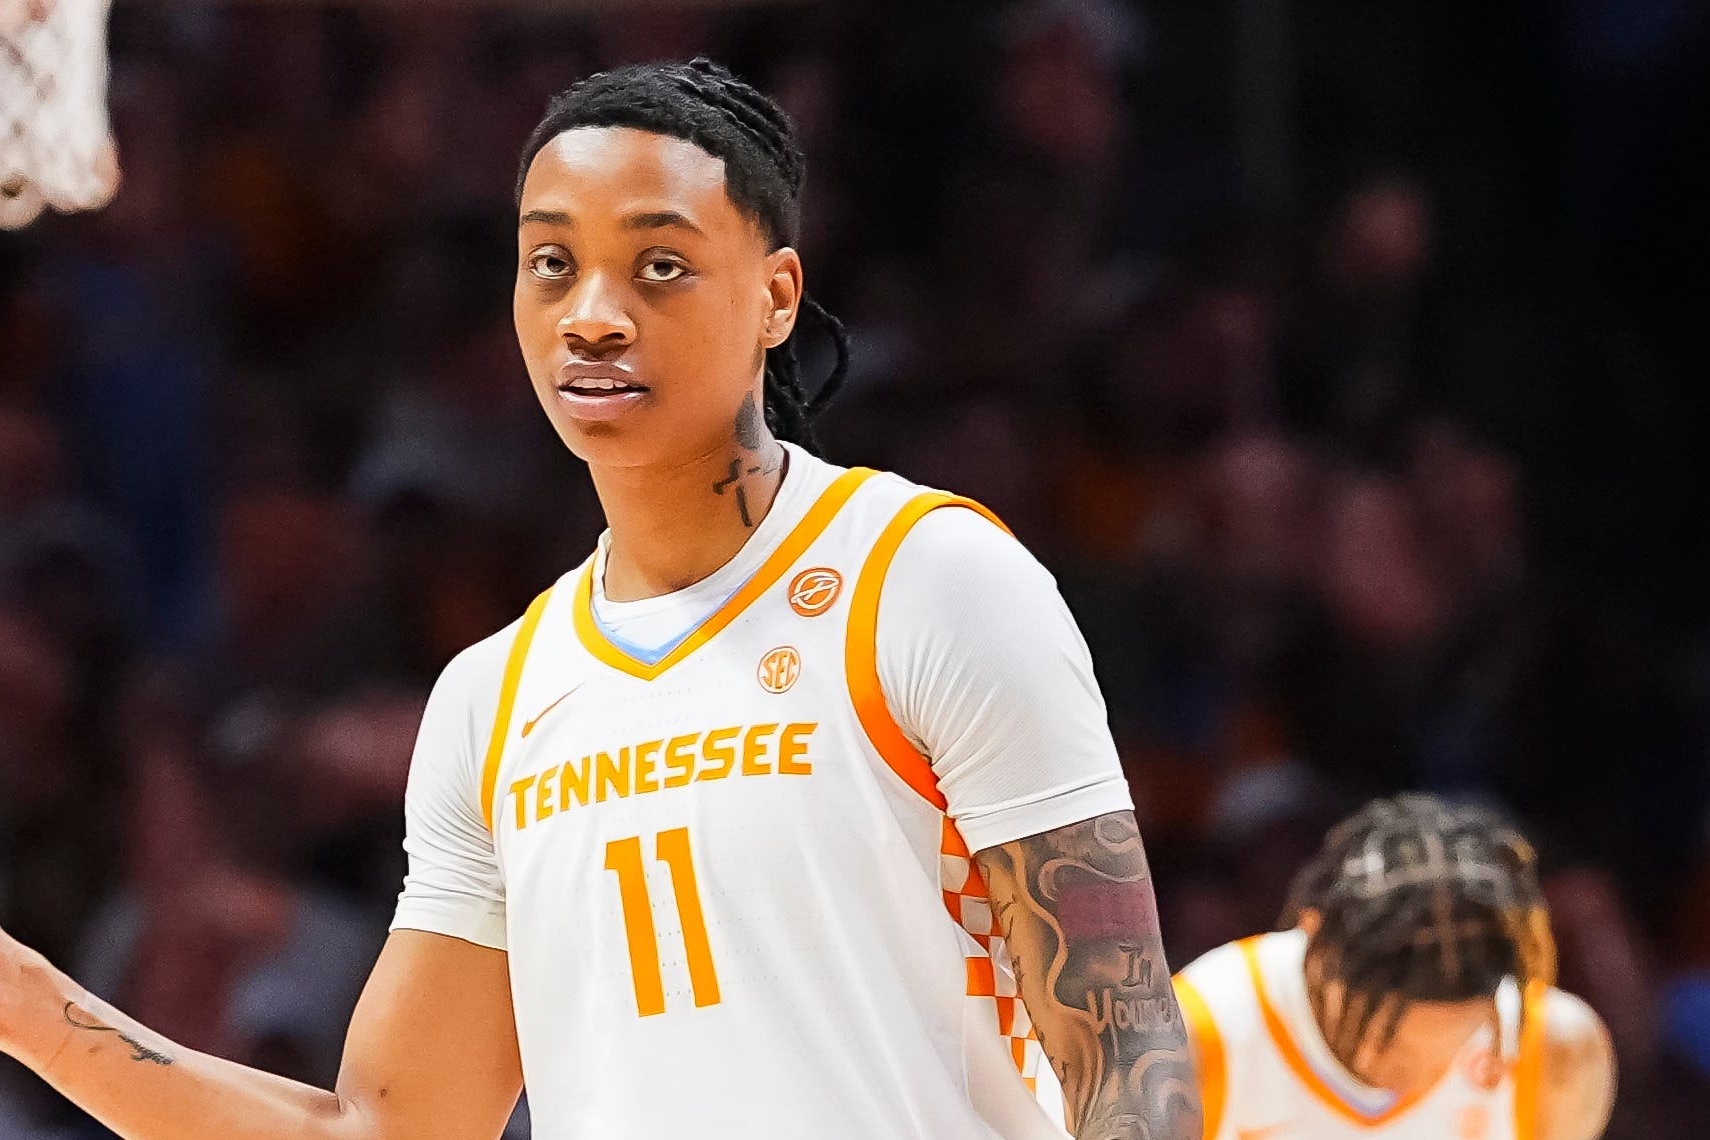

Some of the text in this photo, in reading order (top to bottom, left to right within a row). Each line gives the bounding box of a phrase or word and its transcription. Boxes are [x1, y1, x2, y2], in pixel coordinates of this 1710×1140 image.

[761, 650, 797, 690] SEC
[507, 722, 819, 831] TENNESSEE
[603, 826, 722, 1018] 11
